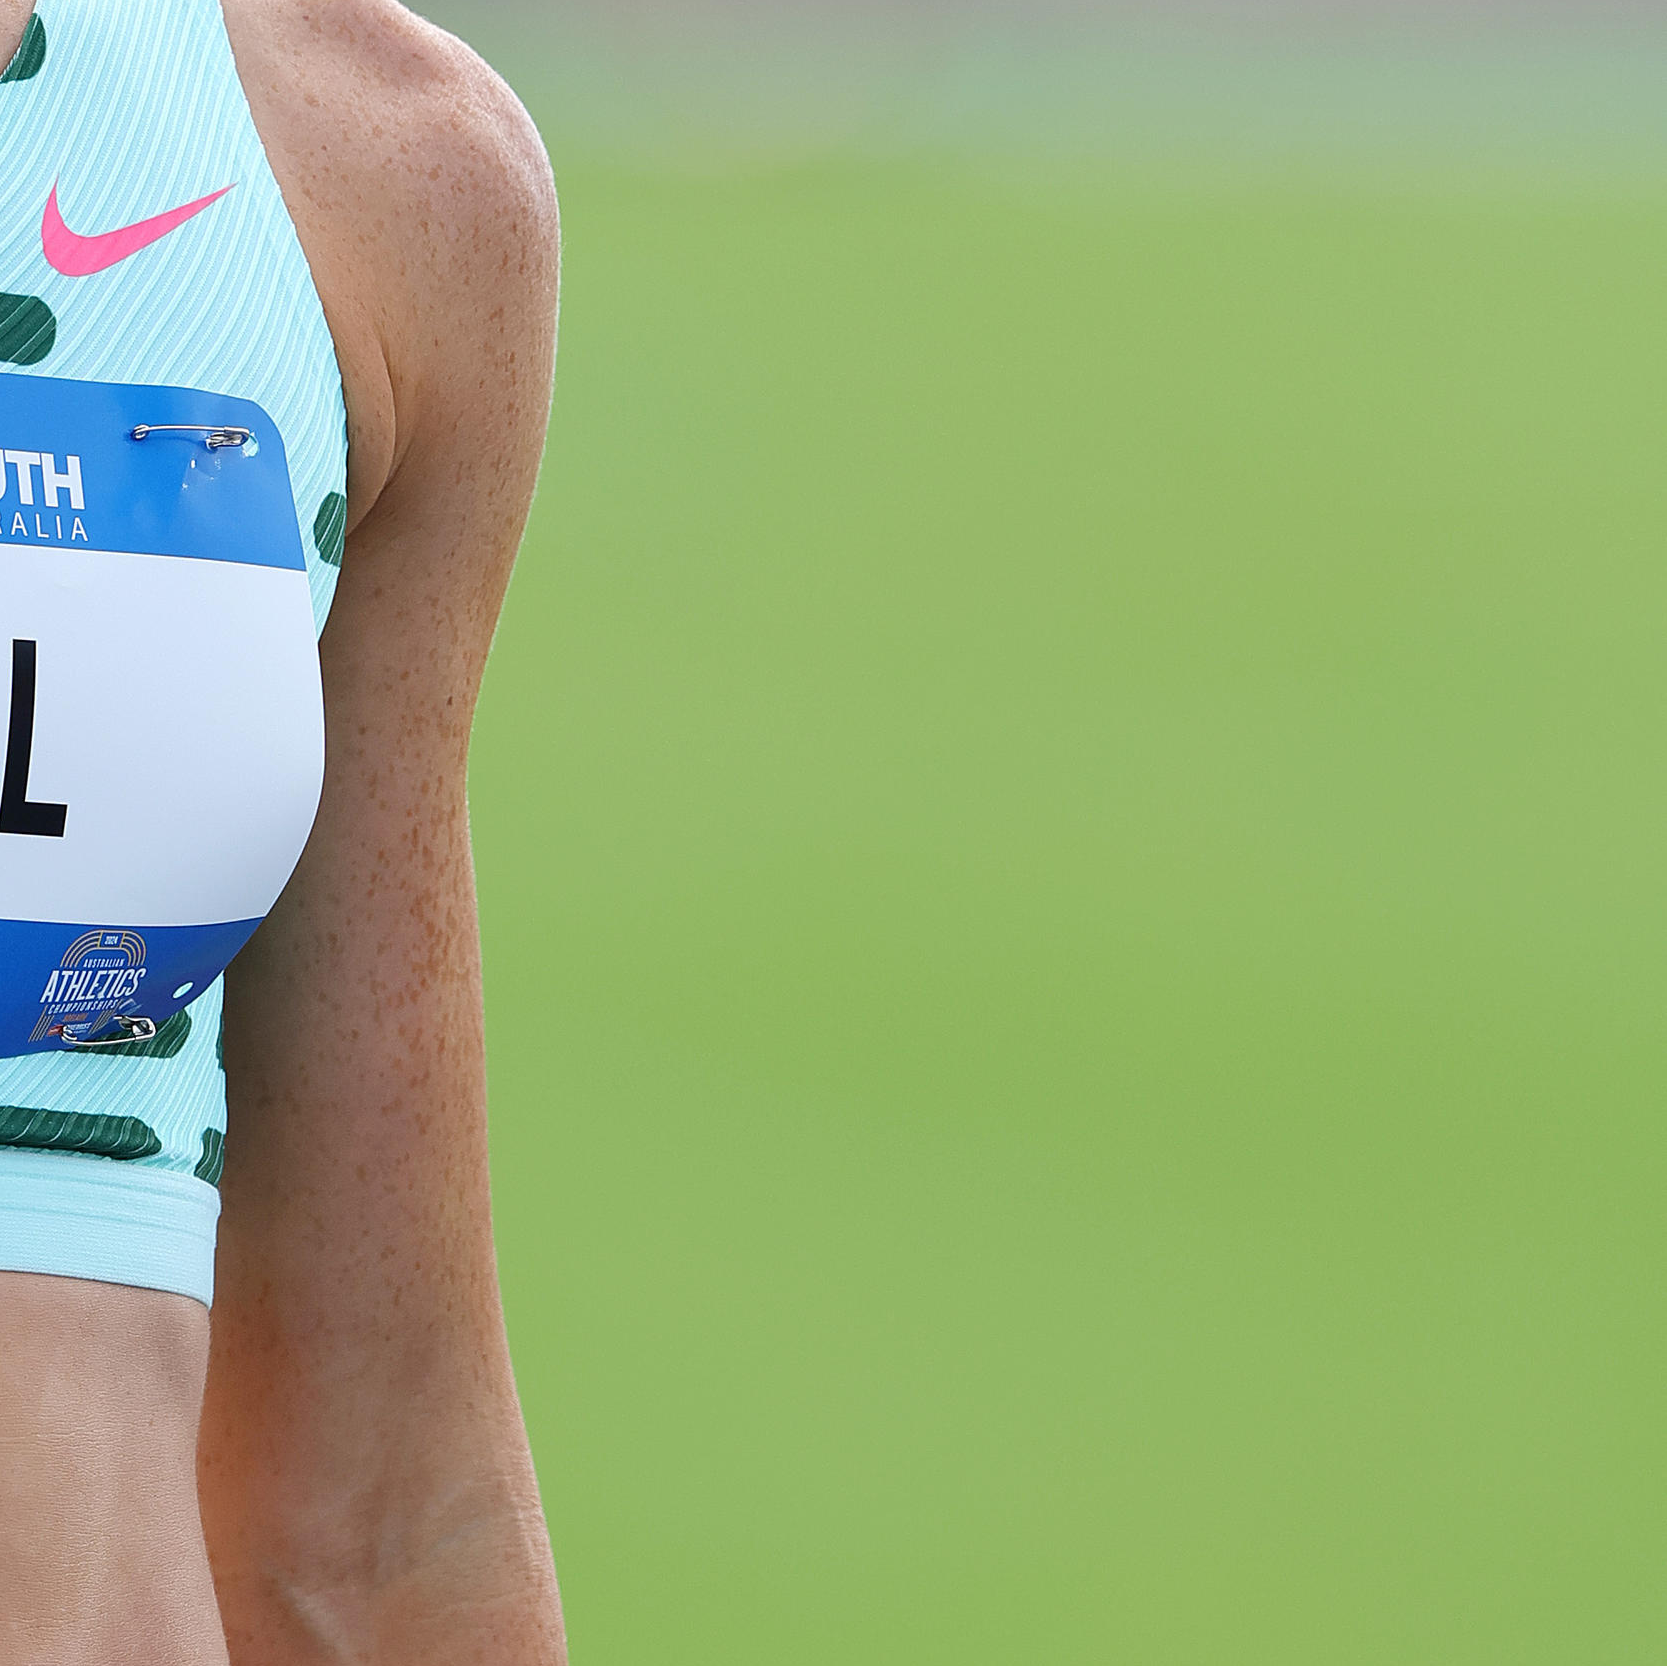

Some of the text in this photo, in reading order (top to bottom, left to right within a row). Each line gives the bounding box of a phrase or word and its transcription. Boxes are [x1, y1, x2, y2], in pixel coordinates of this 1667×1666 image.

[82, 958, 126, 968] AUSTRALIAN
[40, 967, 147, 1003] ATHLETICS
[47, 998, 119, 1015] CHAMPIONSHIPS
